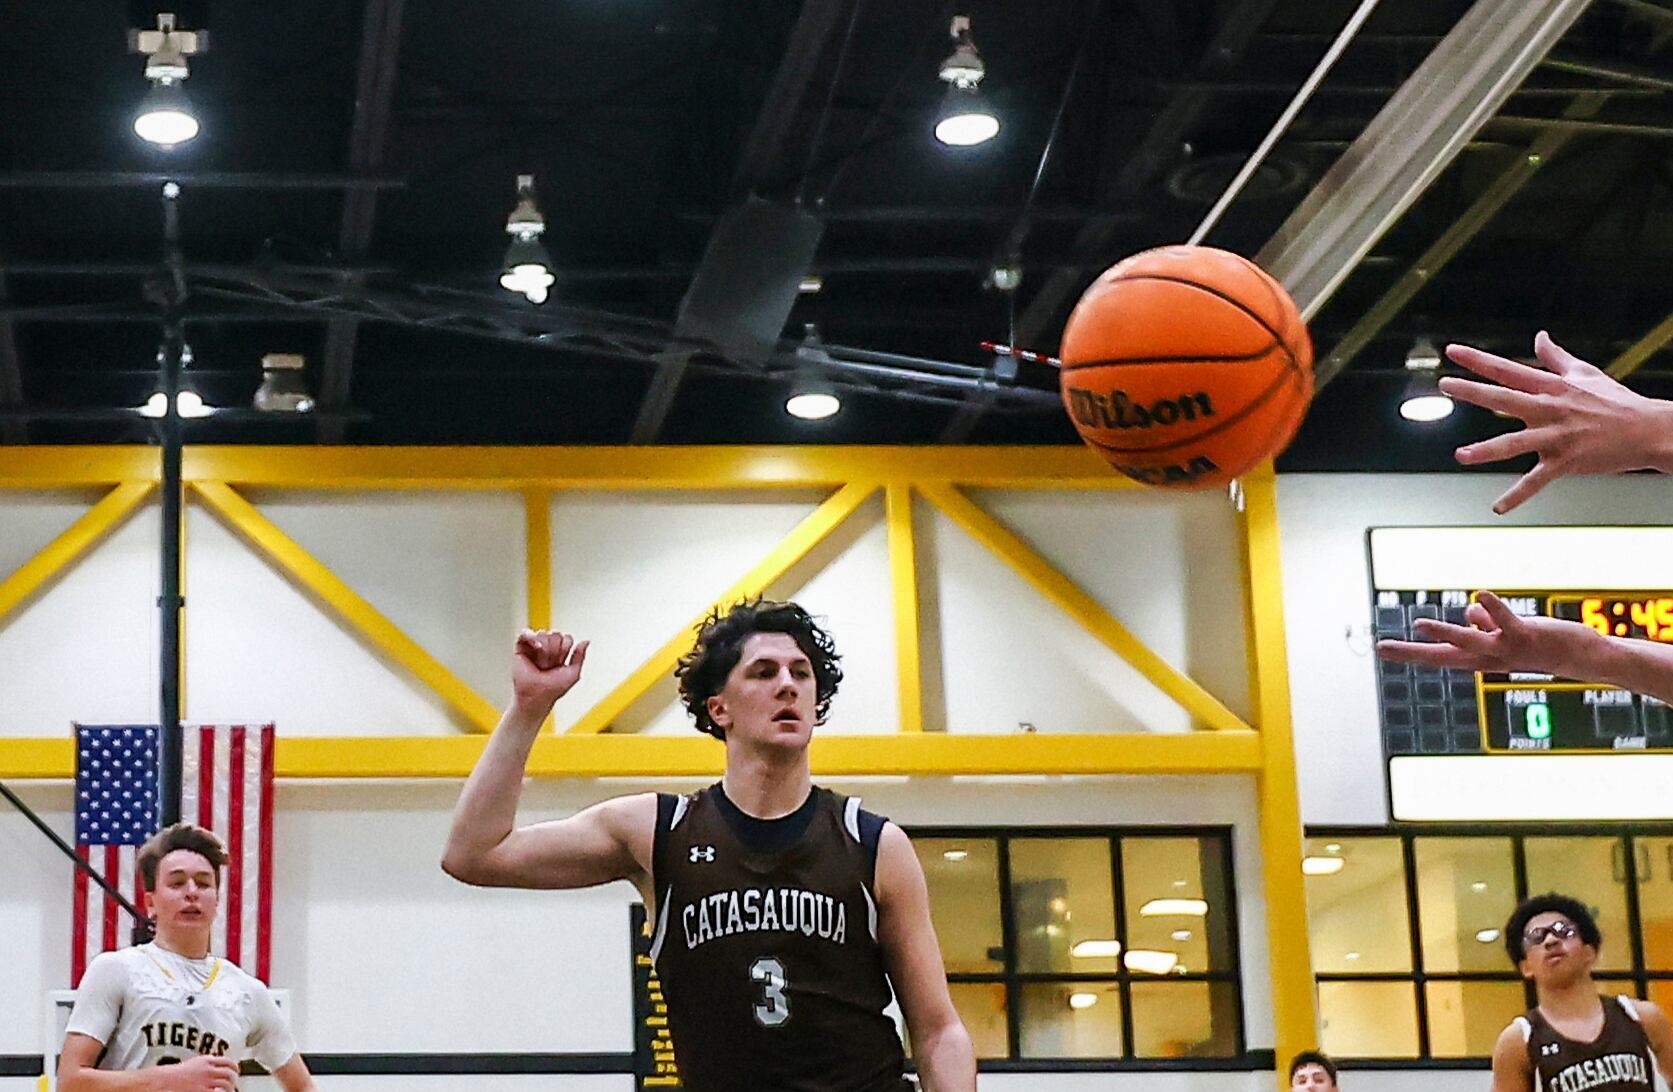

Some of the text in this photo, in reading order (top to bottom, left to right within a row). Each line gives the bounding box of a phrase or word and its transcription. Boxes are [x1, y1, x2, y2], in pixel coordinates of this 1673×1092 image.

[1069, 387, 1215, 429] Wilson
[1526, 703, 1550, 739] 0
[683, 888, 846, 949] CATASAUQUA
[750, 957, 790, 1026] 3
[141, 1022, 229, 1056] TIGERS
